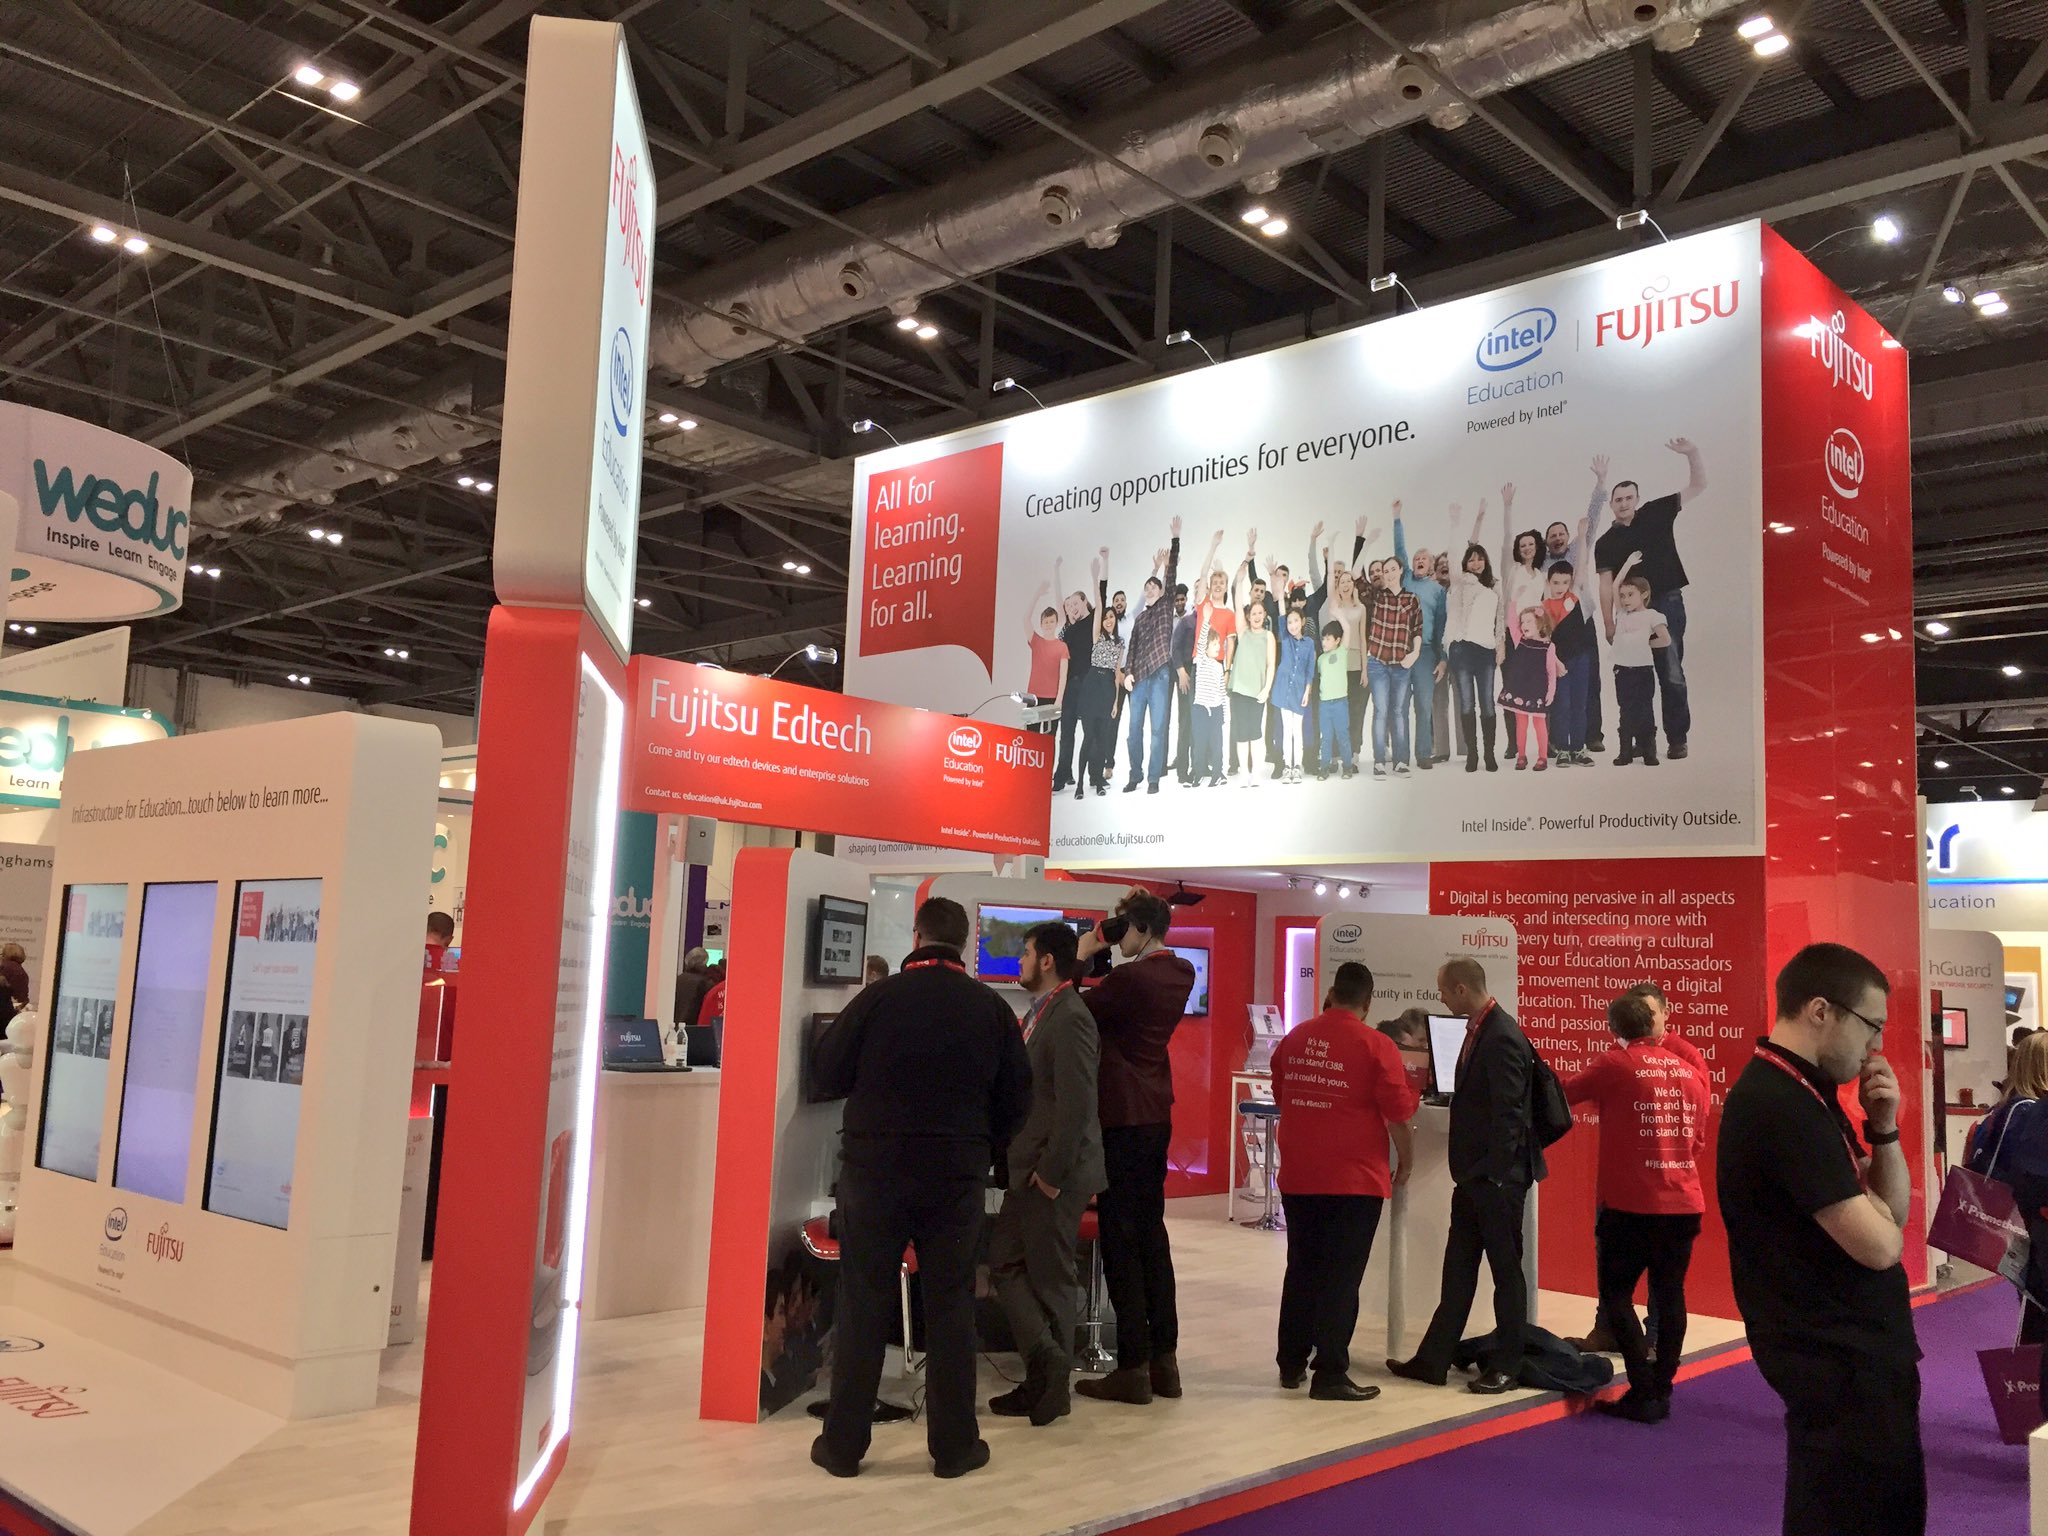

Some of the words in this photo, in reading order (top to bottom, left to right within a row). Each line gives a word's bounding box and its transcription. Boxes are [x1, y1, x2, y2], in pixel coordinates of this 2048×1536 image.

[613, 141, 647, 306] FUJITSU
[1595, 279, 1740, 349] FUJITSU
[1487, 318, 1544, 356] intel
[1810, 314, 1873, 400] FUJITSU
[613, 333, 630, 415] intel
[1467, 370, 1564, 405] Education
[1466, 411, 1515, 433] Powered
[1519, 409, 1533, 424] by
[1830, 434, 1860, 482] intel
[1025, 485, 1102, 518] Creating
[1109, 454, 1249, 506] opportunities
[1257, 442, 1289, 472] for
[1296, 420, 1416, 461] everyone.
[874, 479, 902, 513] All
[908, 476, 936, 506] for
[34, 458, 188, 561] weduc
[1821, 494, 1870, 546] Education
[874, 513, 966, 550] learning.
[46, 526, 100, 551] Inspire
[108, 542, 143, 565] Learn
[148, 555, 177, 582] Engage
[1822, 541, 1848, 571] Powered
[1849, 556, 1856, 579] by
[872, 552, 963, 590] Learning
[870, 598, 898, 628] for
[901, 589, 933, 623] all.
[650, 678, 759, 737] Fujitsu
[772, 700, 872, 755] Edtech
[952, 731, 978, 749] intel
[648, 742, 673, 757] Come
[675, 746, 692, 760] and
[693, 750, 705, 765] try
[707, 754, 721, 765] our
[722, 754, 750, 769] edtech
[752, 758, 781, 774] devices
[782, 763, 798, 776] and
[799, 767, 836, 783] enterprise
[837, 772, 870, 787] solutions
[943, 757, 984, 774] Education
[995, 743, 1045, 769] FUJITSU
[9, 775, 50, 790] Learn
[943, 774, 965, 786] Powered
[965, 777, 971, 787] by
[71, 803, 124, 824] Infrastructure
[125, 800, 137, 819] for
[217, 790, 247, 814] below
[249, 791, 259, 809] to
[262, 786, 289, 807] learn
[292, 787, 328, 805] more...
[645, 786, 671, 799] Contact
[671, 790, 682, 800] us:
[682, 791, 763, 810] education@uk.fujitsu.com
[1461, 819, 1487, 832] Intel
[1539, 814, 1595, 831] Powerful
[1599, 812, 1679, 830] Productivity
[1683, 809, 1742, 826] Outside.
[940, 826, 953, 835] Intel
[972, 830, 994, 840] Powerful
[994, 833, 1021, 845] Productivity
[1022, 837, 1042, 847] Outside.
[1055, 832, 1164, 848] education@uk.fujitsu.com
[848, 843, 877, 855] shaping
[0, 854, 54, 869] nghams
[1450, 889, 1488, 908] Digital
[1492, 890, 1502, 905] is
[1506, 889, 1568, 909] becoming
[1573, 890, 1637, 909] pervasive
[1641, 890, 1654, 905] in
[1659, 889, 1675, 905] all
[1680, 890, 1735, 909] aspects
[1928, 895, 1996, 909] ucation
[1523, 911, 1548, 925] and
[1552, 911, 1629, 930] intersecting
[1634, 914, 1671, 926] more
[1675, 910, 1707, 927] with
[1336, 929, 1357, 938] intel
[1462, 934, 1509, 950] FUJITSU
[1516, 933, 1549, 950] every
[1553, 933, 1583, 948] turn,
[1588, 933, 1642, 951] creating
[1647, 937, 1656, 948] a
[1661, 932, 1714, 949] cultural
[1300, 967, 1314, 978] BR
[1516, 955, 1535, 966] eve
[1538, 955, 1560, 966] our
[1564, 952, 1631, 968] Education
[1633, 953, 1733, 972] Ambassadors
[1372, 988, 1400, 1002] curity
[1403, 989, 1413, 1000] in
[1416, 989, 1441, 1001] Educ
[1529, 975, 1600, 989] movement
[1662, 979, 1671, 992] a
[1676, 976, 1722, 997] digital
[1517, 991, 1576, 1009] ducation.
[1665, 997, 1684, 1014] he
[1688, 1002, 1729, 1016] same
[1531, 1013, 1555, 1028] and
[1686, 1021, 1714, 1038] and
[1719, 1026, 1745, 1039] our
[620, 1033, 642, 1044] FUJITSU
[1307, 1036, 1317, 1046] It's
[1318, 1039, 1330, 1050] big.
[1305, 1046, 1315, 1056] It's
[1316, 1049, 1328, 1058] red.
[1697, 1044, 1716, 1060] nd
[1296, 1057, 1305, 1065] on
[1305, 1058, 1325, 1068] stand
[1325, 1060, 1345, 1072] C388.
[1554, 1056, 1582, 1073] that
[1709, 1066, 1726, 1084] nd
[1635, 1068, 1667, 1080] security
[1294, 1072, 1299, 1081] it
[1299, 1073, 1317, 1083] could
[1317, 1075, 1326, 1084] be
[1327, 1079, 1350, 1089] yours.
[1654, 1086, 1668, 1097] We
[1669, 1086, 1685, 1097] do.
[1633, 1101, 1661, 1111] Come
[1663, 1100, 1680, 1111] and
[1640, 1113, 1664, 1124] from
[1664, 1113, 1680, 1124] the
[1640, 1128, 1653, 1137] on
[1656, 1126, 1679, 1137] stand
[146, 1232, 185, 1262] FUJITSU
[2016, 1380, 2041, 1393] Pro
